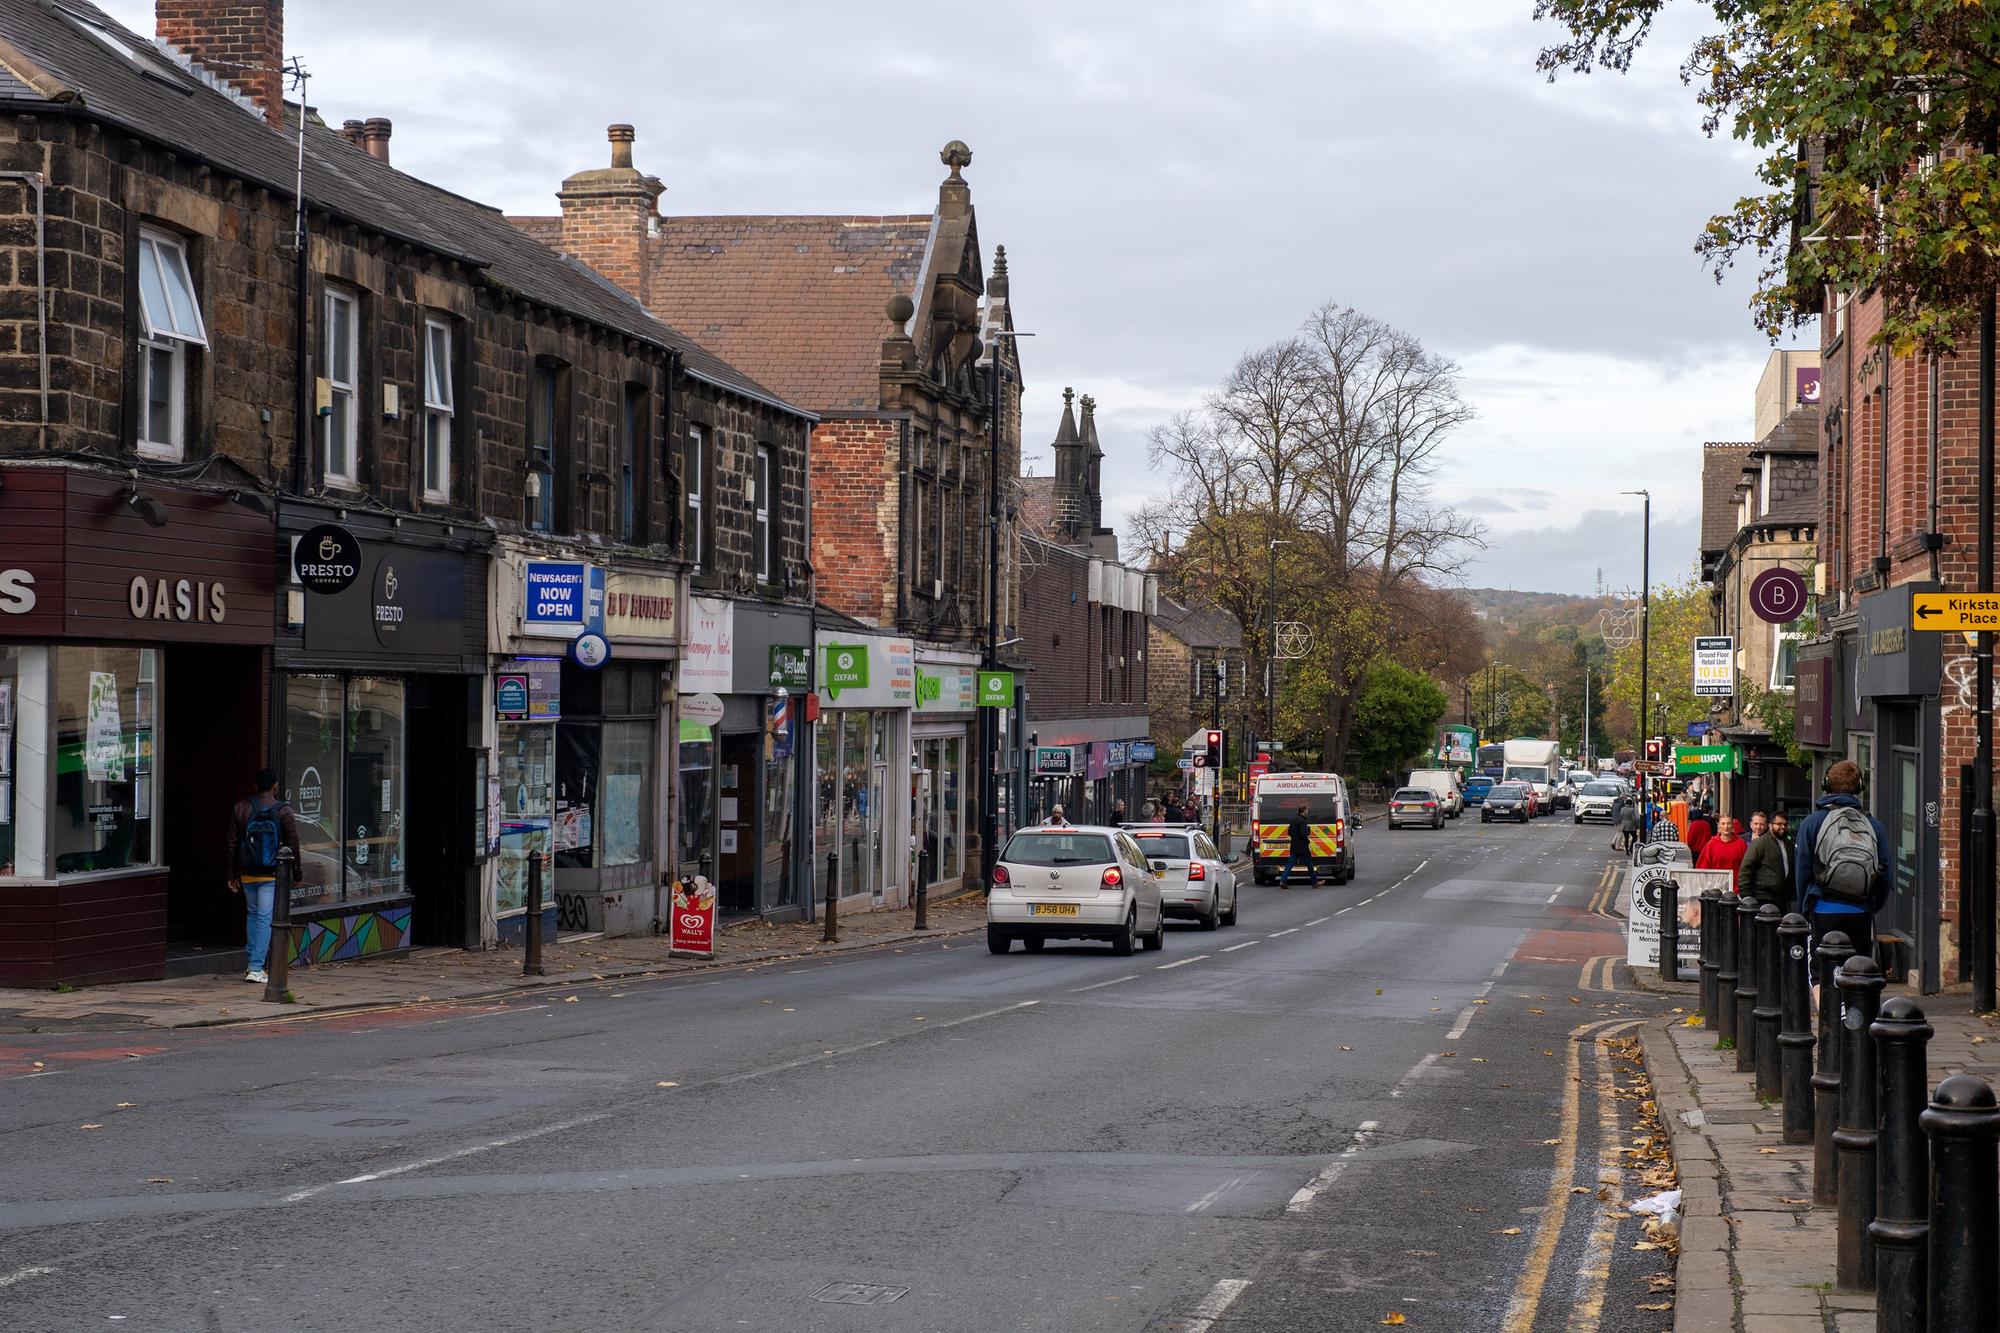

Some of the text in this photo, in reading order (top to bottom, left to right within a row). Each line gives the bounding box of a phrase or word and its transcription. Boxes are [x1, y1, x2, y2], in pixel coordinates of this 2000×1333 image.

[301, 564, 354, 577] PRESTO
[529, 572, 583, 583] NEWSAGENT
[130, 575, 226, 623] OASIS
[540, 587, 571, 600] NOW
[1773, 587, 1786, 604] B
[376, 605, 403, 622] PRESTO
[537, 603, 573, 616] OPEN
[1960, 612, 1998, 624] Place
[686, 632, 712, 661] harming
[834, 673, 858, 682] OXFAM
[1699, 667, 1729, 678] TO LET
[1680, 754, 1726, 764] SUBWAY
[300, 786, 321, 800] PRESTO
[1637, 869, 1668, 884] THE VI
[1035, 904, 1077, 914] BJ58 UHA
[681, 928, 704, 936] WALL'S
